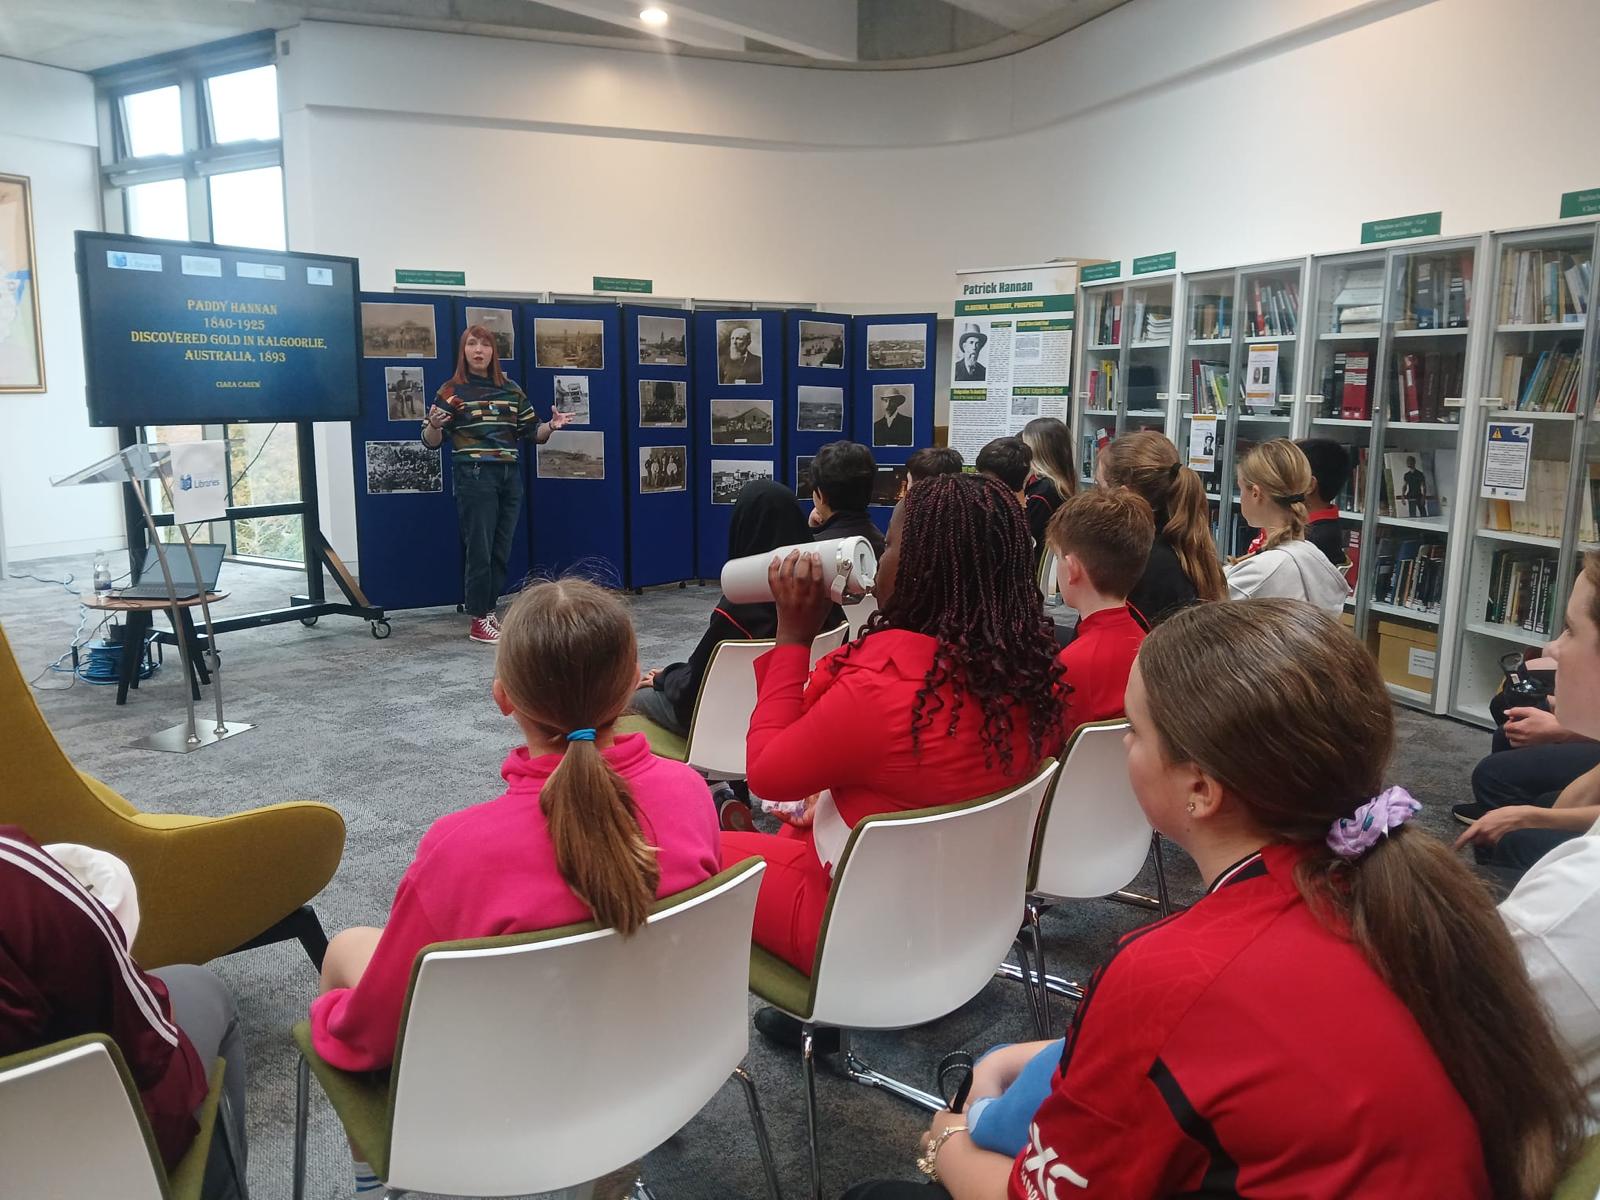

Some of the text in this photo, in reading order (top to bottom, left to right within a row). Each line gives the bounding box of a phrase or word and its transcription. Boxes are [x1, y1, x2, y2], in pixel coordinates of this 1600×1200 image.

[963, 281, 1033, 296] Patrick Hannan
[187, 299, 278, 316] PADDY HANNAN
[204, 318, 265, 331] 1840-1925
[131, 331, 328, 349] DISCOVERED GOLD IN KALGOORLIE,
[184, 350, 286, 364] AUSTRALIA, 1893
